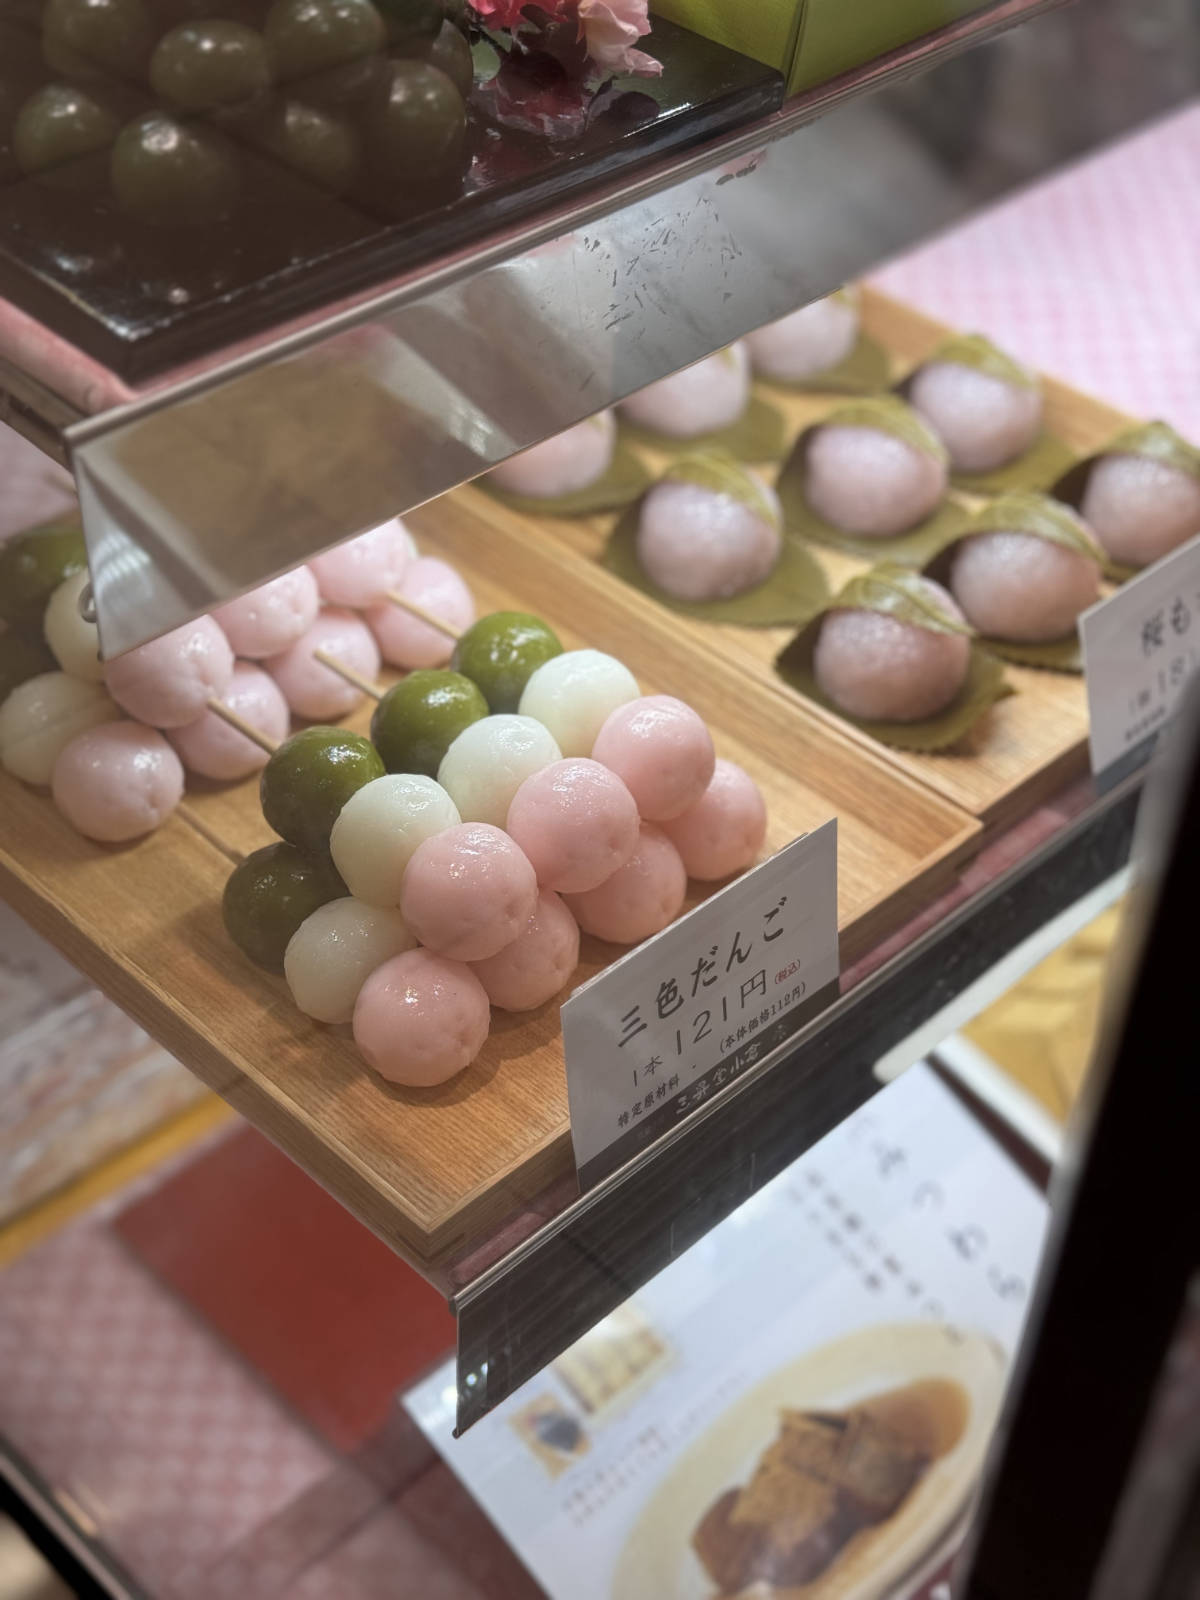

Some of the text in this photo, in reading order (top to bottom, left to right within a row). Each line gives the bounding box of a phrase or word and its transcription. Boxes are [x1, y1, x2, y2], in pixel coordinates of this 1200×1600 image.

[1141, 591, 1200, 658] 桜も
[617, 895, 789, 1048] 三色だんご
[633, 1054, 662, 1087] 1本
[675, 968, 767, 1056] 121円
[617, 1073, 681, 1129] 特定原材料
